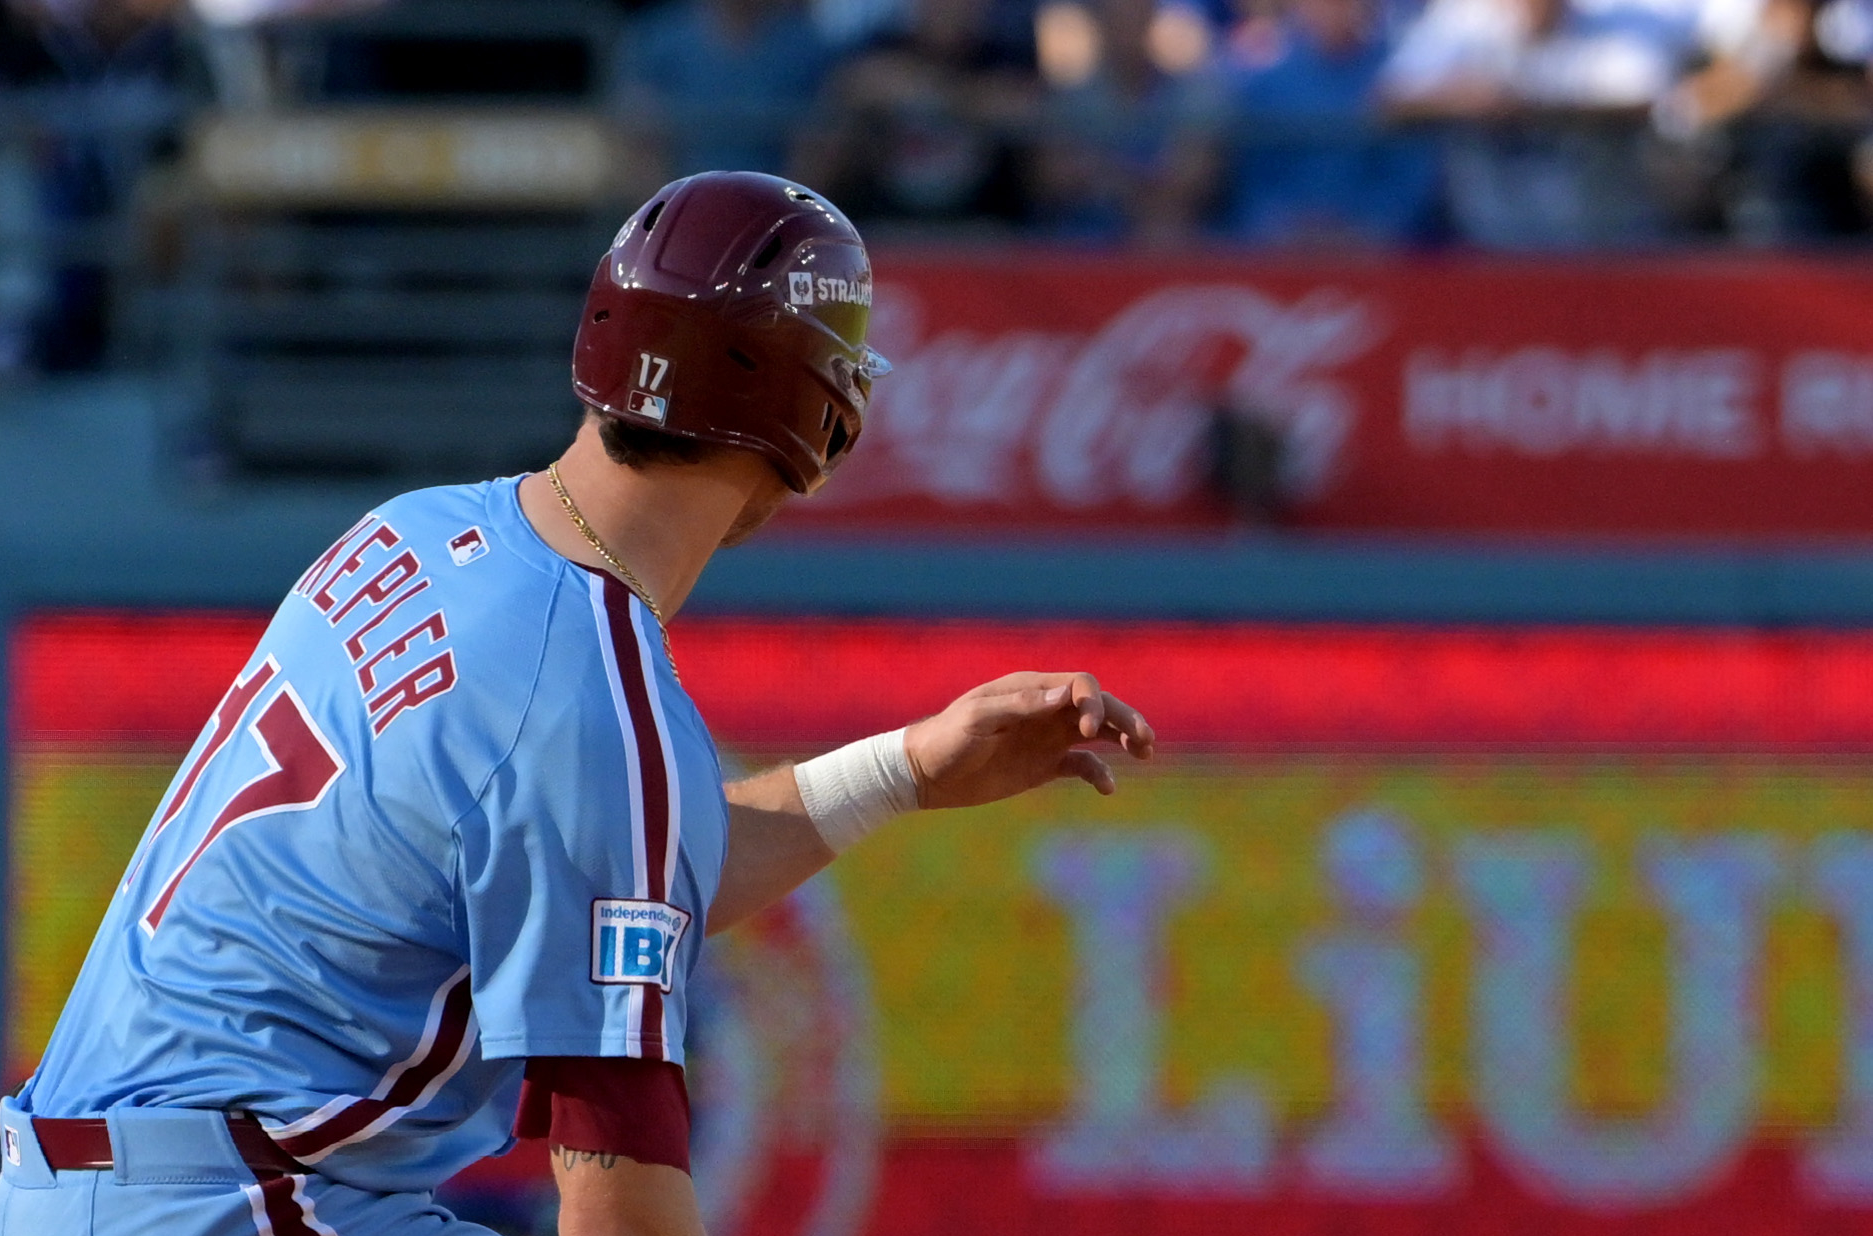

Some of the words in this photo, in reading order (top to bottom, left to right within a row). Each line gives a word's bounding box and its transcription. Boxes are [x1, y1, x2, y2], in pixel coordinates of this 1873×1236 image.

[638, 352, 669, 392] 17
[1402, 346, 1762, 460] HOME
[242, 512, 459, 741] KEPLER
[123, 652, 347, 941] 17
